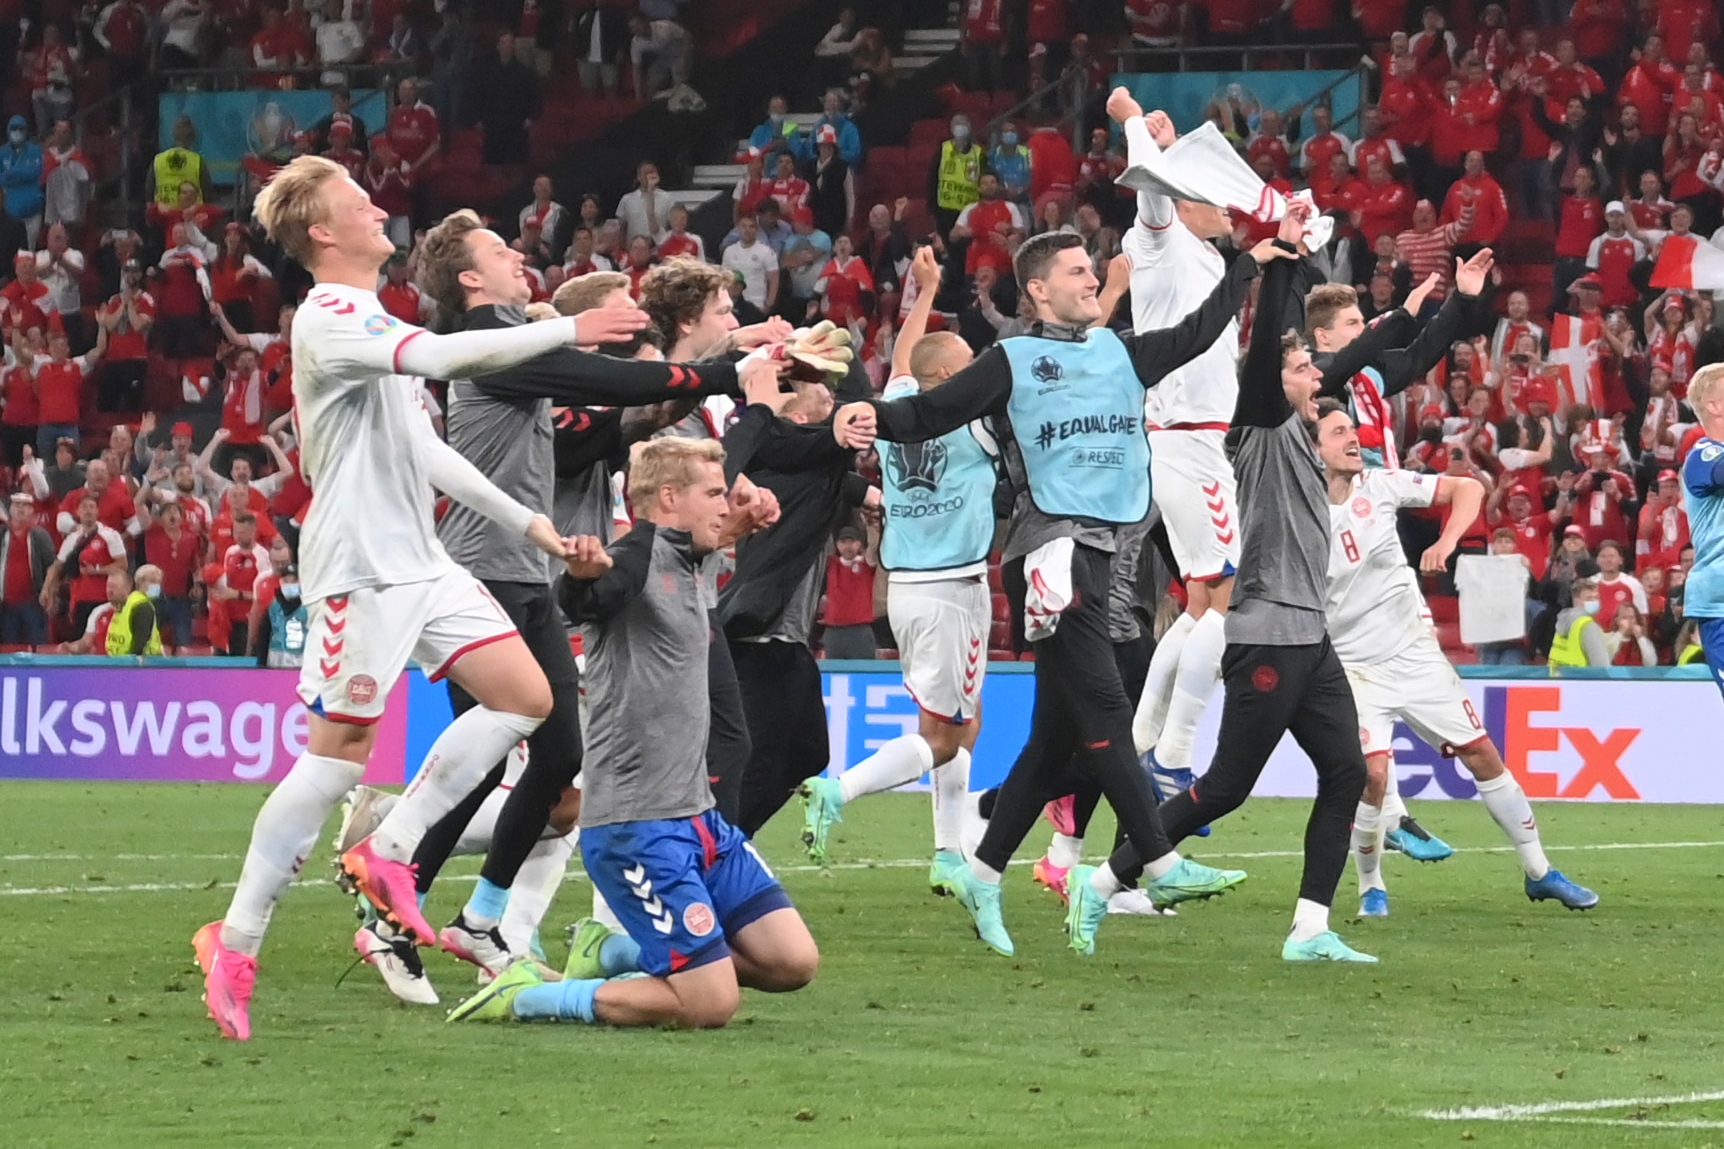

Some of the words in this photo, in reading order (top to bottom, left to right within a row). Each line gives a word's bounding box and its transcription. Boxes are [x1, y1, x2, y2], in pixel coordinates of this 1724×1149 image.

[1340, 529, 1361, 563] 8
[0, 677, 312, 779] lkswage
[1390, 686, 1642, 799] edEx
[1462, 698, 1482, 730] 8
